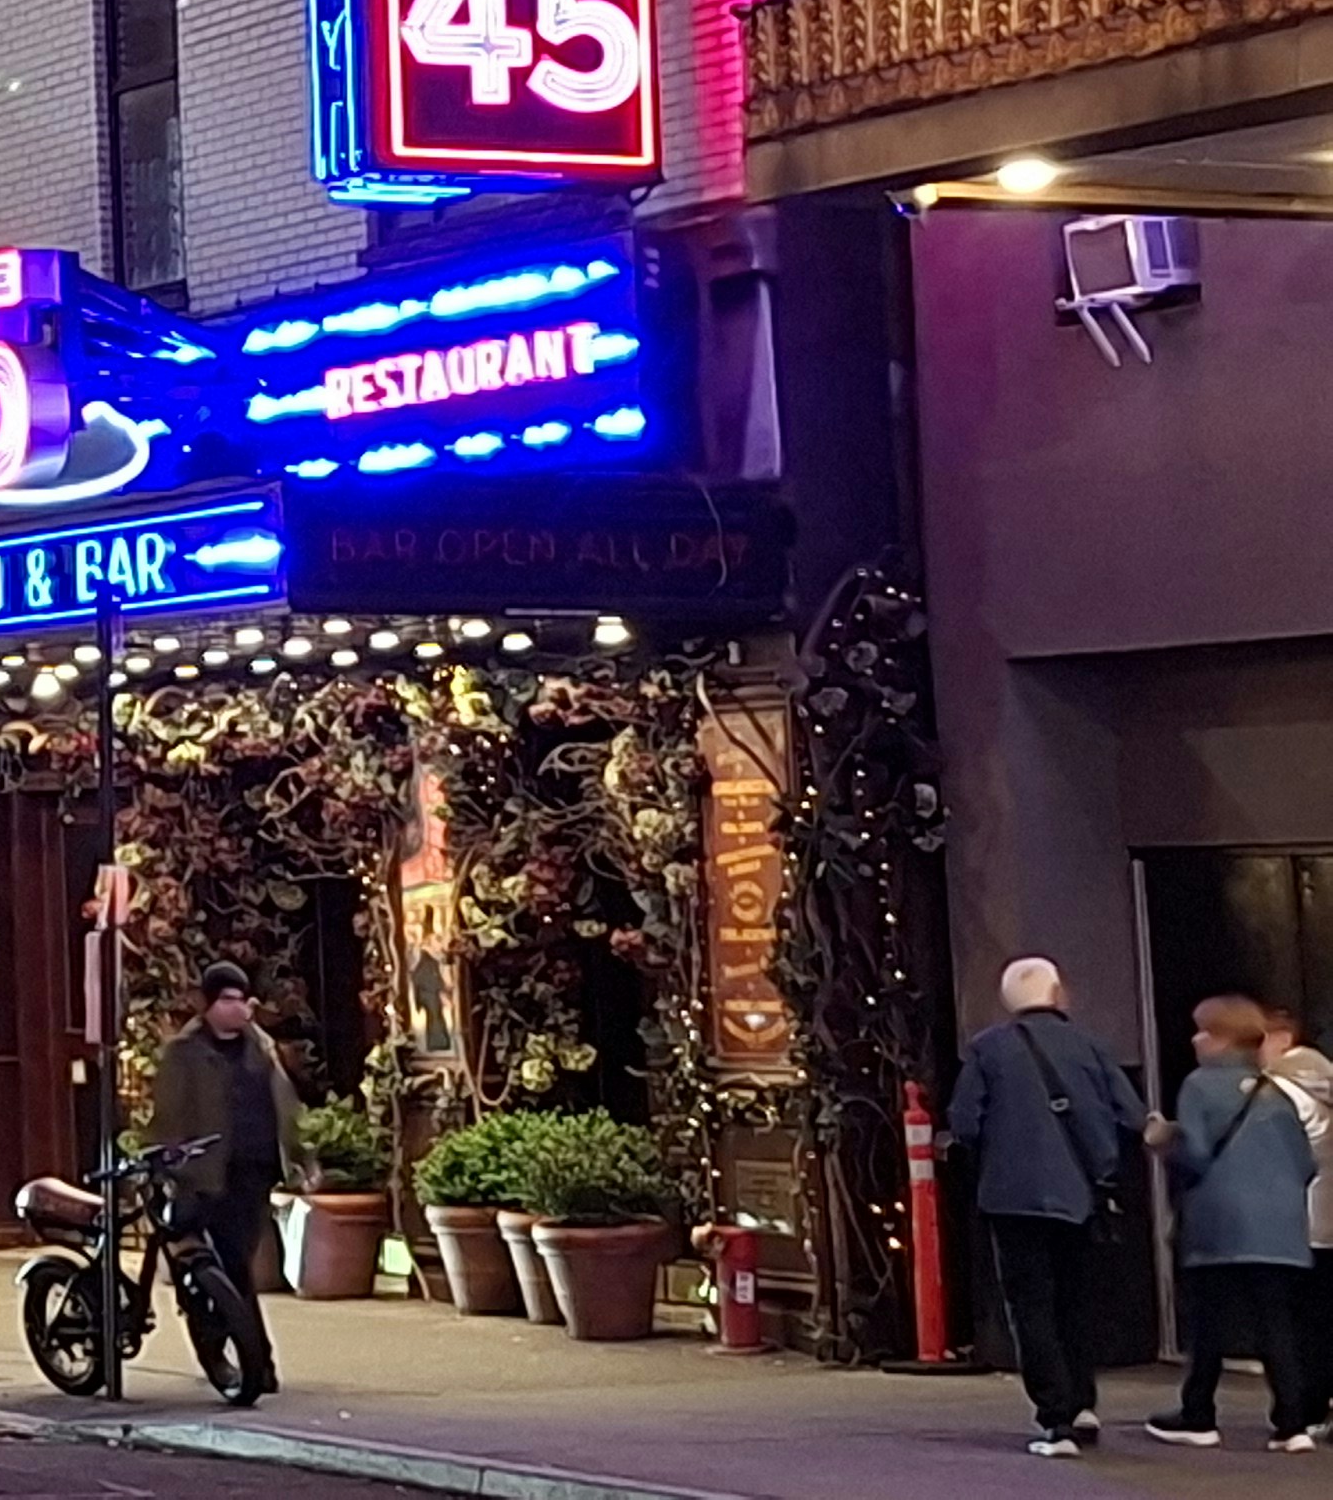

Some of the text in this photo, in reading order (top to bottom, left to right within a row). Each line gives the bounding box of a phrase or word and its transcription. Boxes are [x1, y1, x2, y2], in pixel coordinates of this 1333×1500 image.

[324, 321, 600, 419] RESTAURANT
[26, 547, 54, 607] &
[76, 530, 169, 604] BAR
